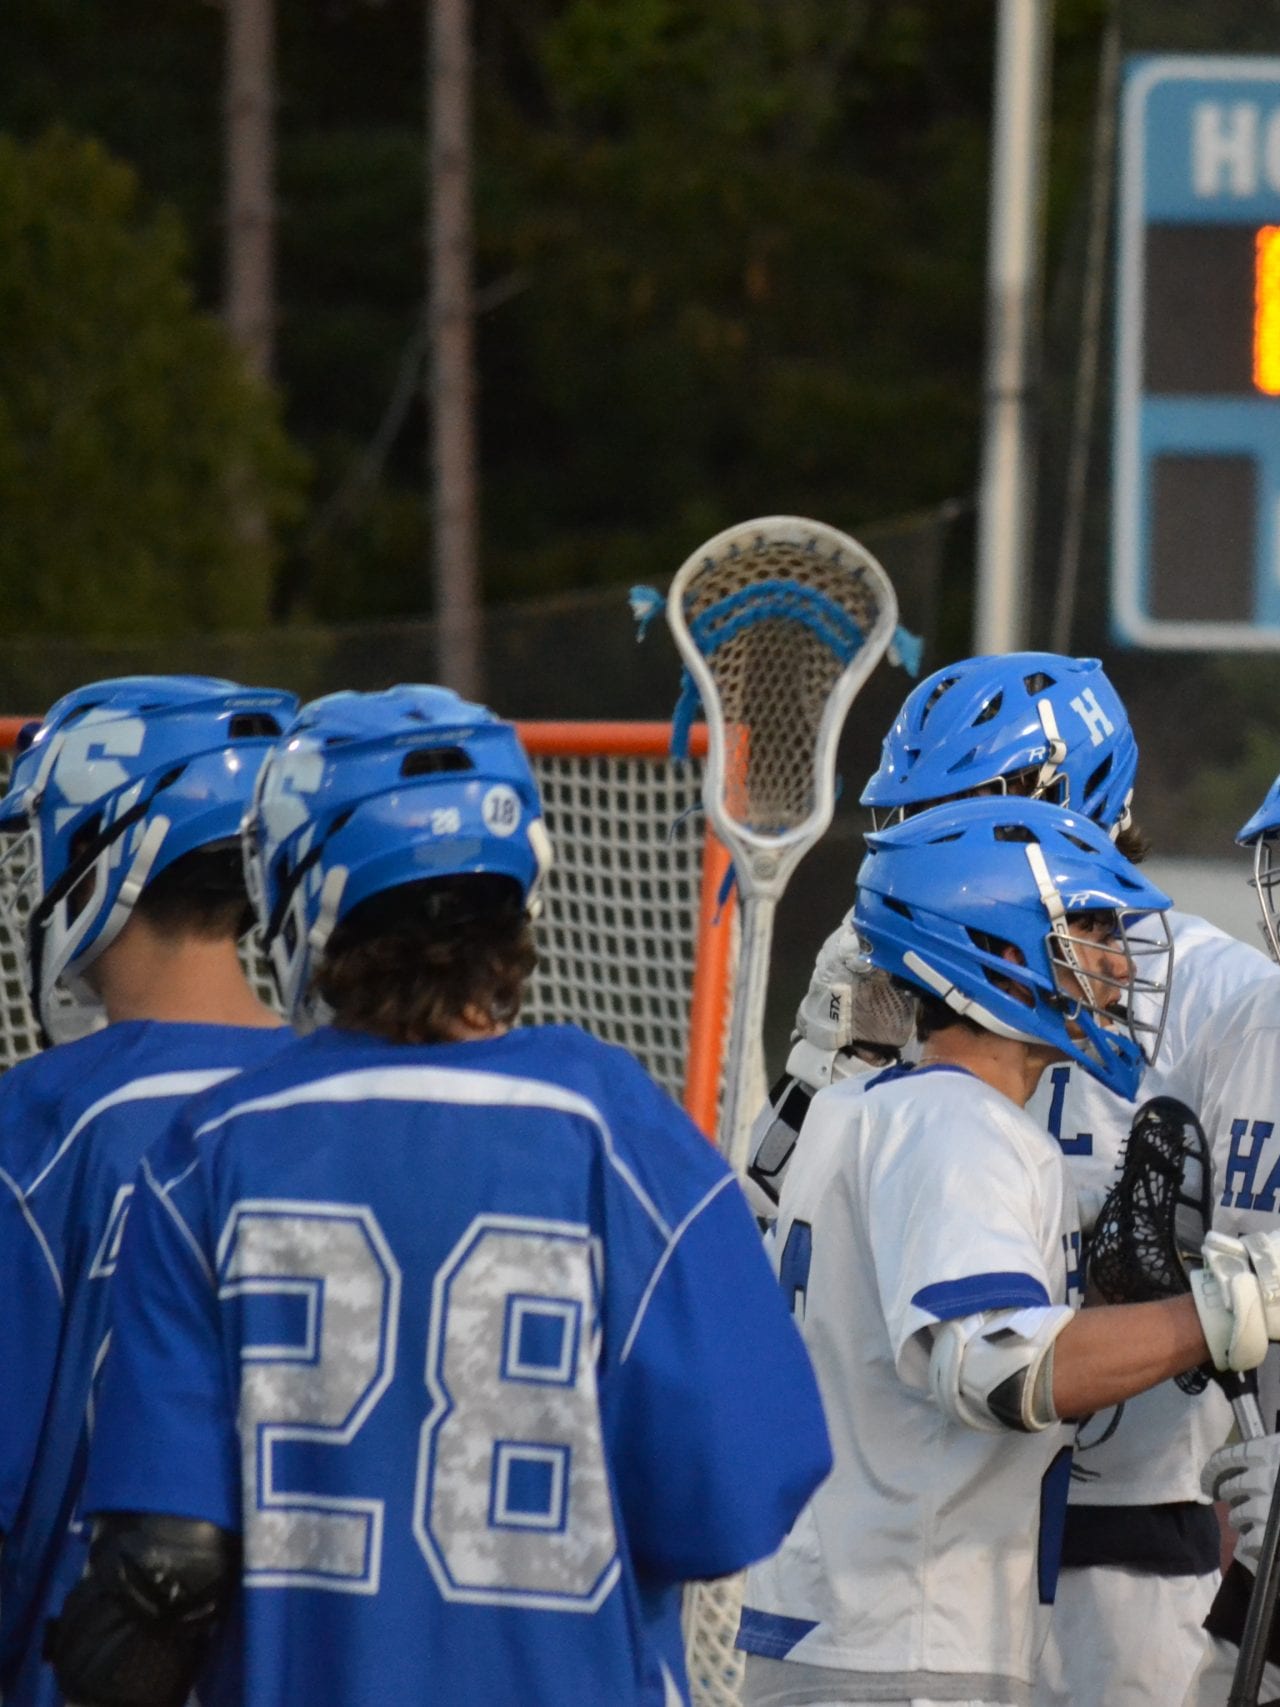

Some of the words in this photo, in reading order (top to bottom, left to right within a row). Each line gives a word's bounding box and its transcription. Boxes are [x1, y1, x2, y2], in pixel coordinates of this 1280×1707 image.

[1069, 687, 1115, 747] H
[829, 993, 842, 1023] STX
[217, 1199, 623, 1614] 28
